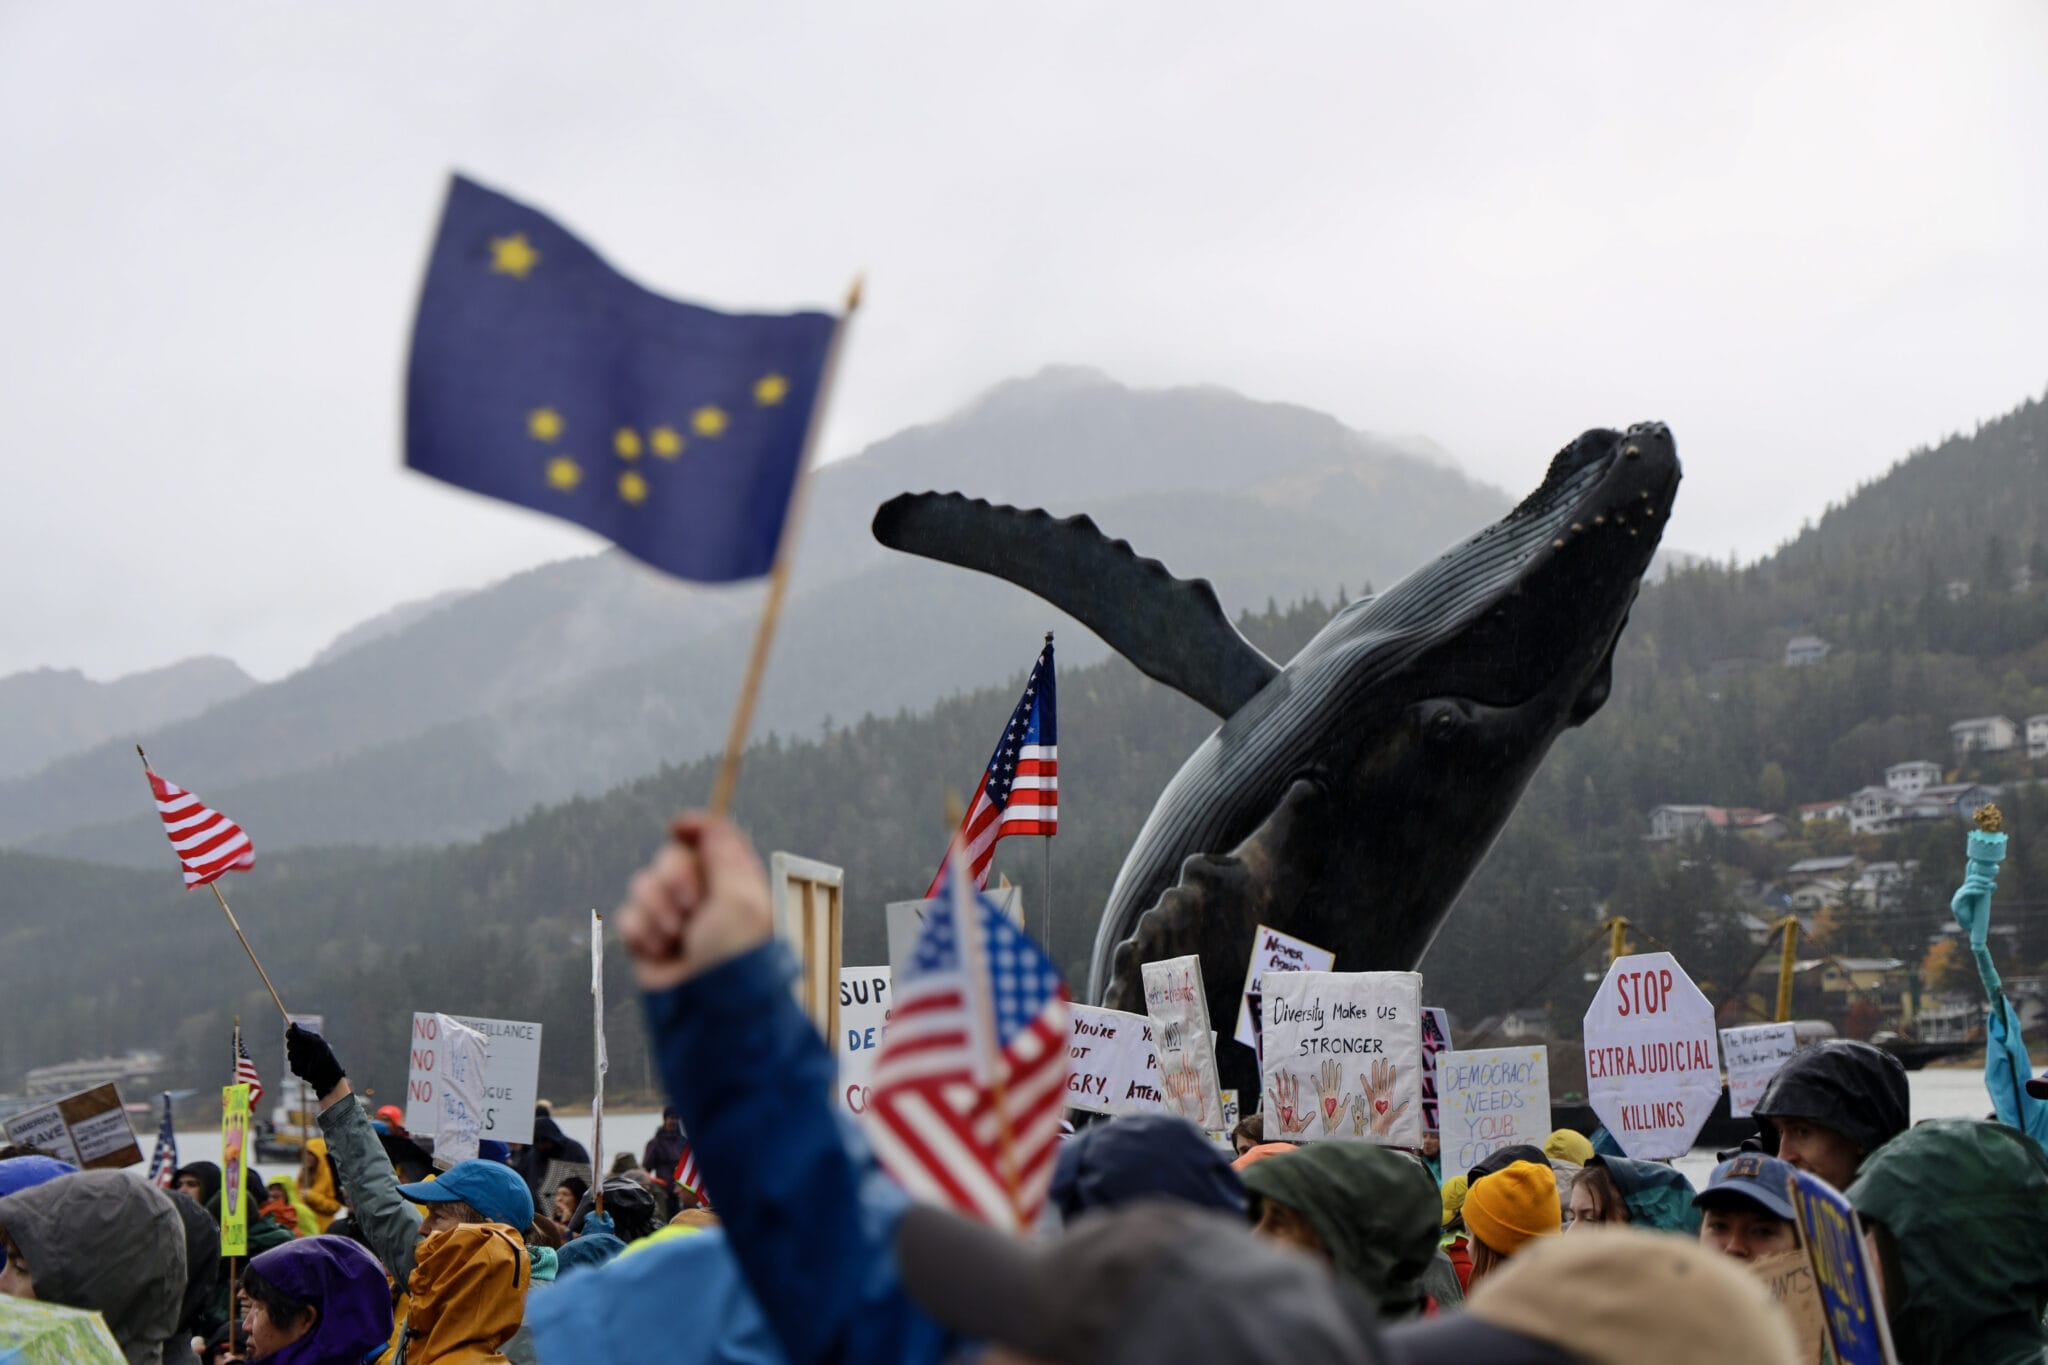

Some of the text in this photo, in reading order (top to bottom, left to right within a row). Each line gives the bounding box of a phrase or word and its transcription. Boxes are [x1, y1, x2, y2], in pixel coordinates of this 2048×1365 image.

[840, 977, 893, 1007] SUP
[1617, 969, 1673, 1017] STOP
[1274, 997, 1325, 1032] Diversity
[414, 1017, 437, 1040] NO
[1067, 1046, 1091, 1059] OT
[1300, 1037, 1384, 1057] STRONGER
[1588, 1039, 1714, 1079] EXTRAJUDICIAL
[411, 1050, 435, 1071] NO
[1446, 1062, 1535, 1092] DEMOCRACY
[409, 1080, 433, 1103] NO
[1125, 1080, 1162, 1103] ATTEN
[1465, 1090, 1524, 1113] NEEDS
[1464, 1114, 1515, 1139] YOUR
[1621, 1101, 1685, 1131] KILLINGS
